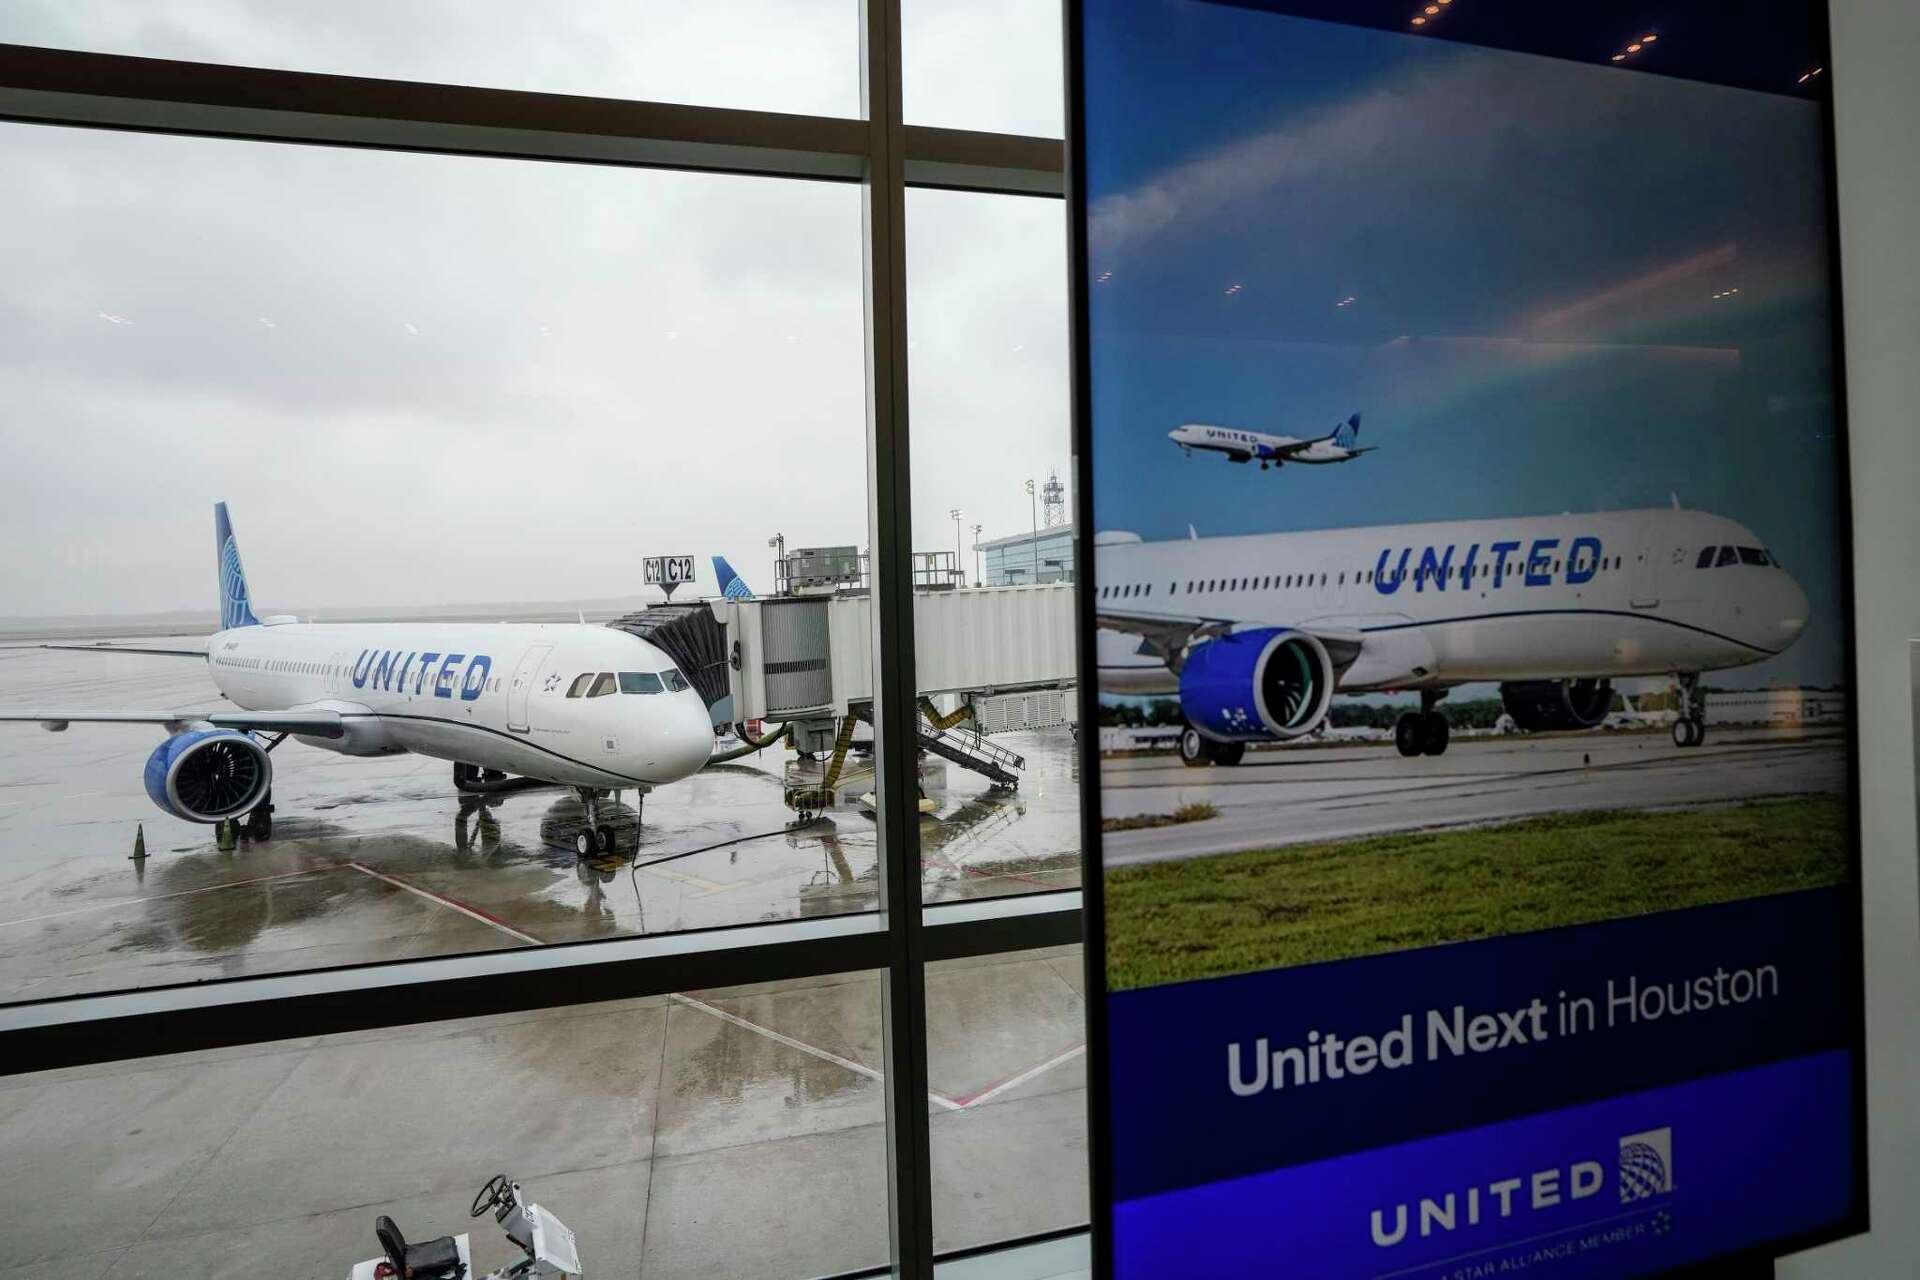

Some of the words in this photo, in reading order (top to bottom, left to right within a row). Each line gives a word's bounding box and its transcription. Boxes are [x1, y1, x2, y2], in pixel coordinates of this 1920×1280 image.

[1206, 428, 1259, 443] UNITED
[646, 560, 660, 581] C12
[669, 559, 691, 580] C12
[1374, 537, 1602, 595] UNITED
[352, 649, 492, 701] UNITED
[1228, 1014, 1413, 1096] United
[1427, 999, 1548, 1060] Next
[1558, 990, 1595, 1036] in
[1607, 965, 1778, 1027] Houston
[1371, 1161, 1604, 1247] UNITED
[1454, 1260, 1495, 1280] STAR
[1500, 1241, 1577, 1272] ALLIANCE
[1579, 1222, 1645, 1251] MEMBER
